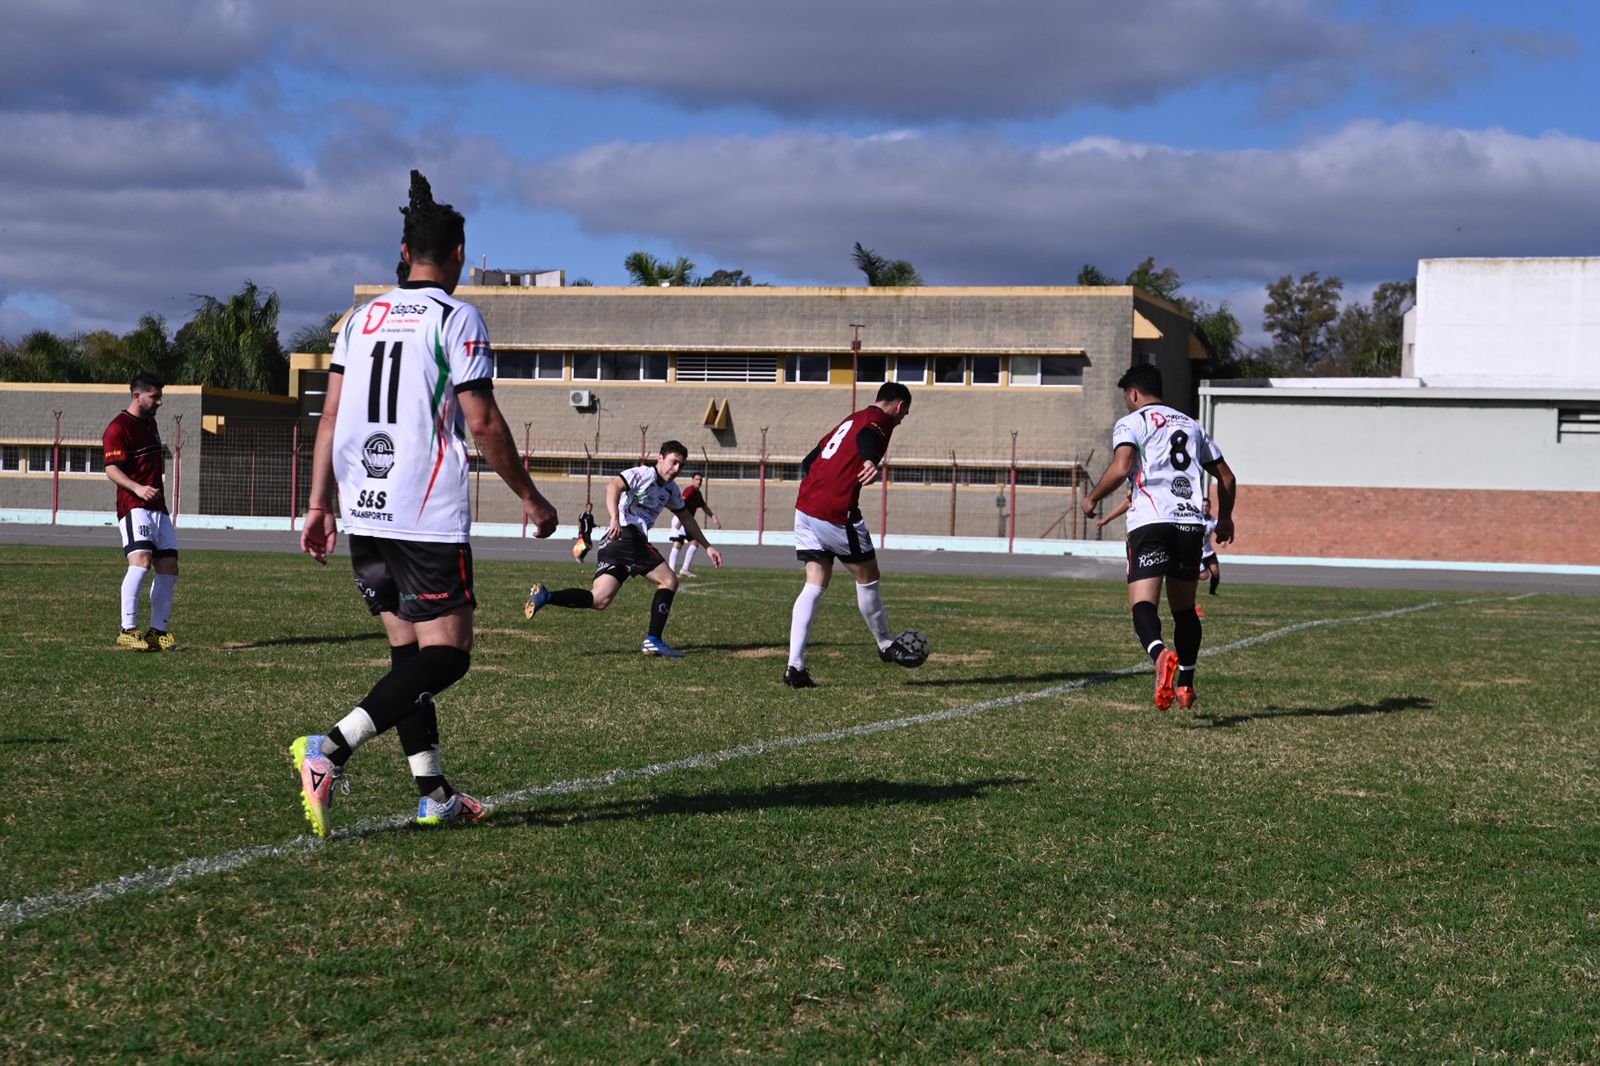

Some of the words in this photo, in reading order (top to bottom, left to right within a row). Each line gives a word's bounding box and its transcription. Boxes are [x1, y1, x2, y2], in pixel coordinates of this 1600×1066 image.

[391, 302, 428, 317] dapsa
[368, 341, 403, 424] 11
[821, 419, 854, 460] 8
[1170, 429, 1192, 471] 8
[357, 489, 387, 509] S&S
